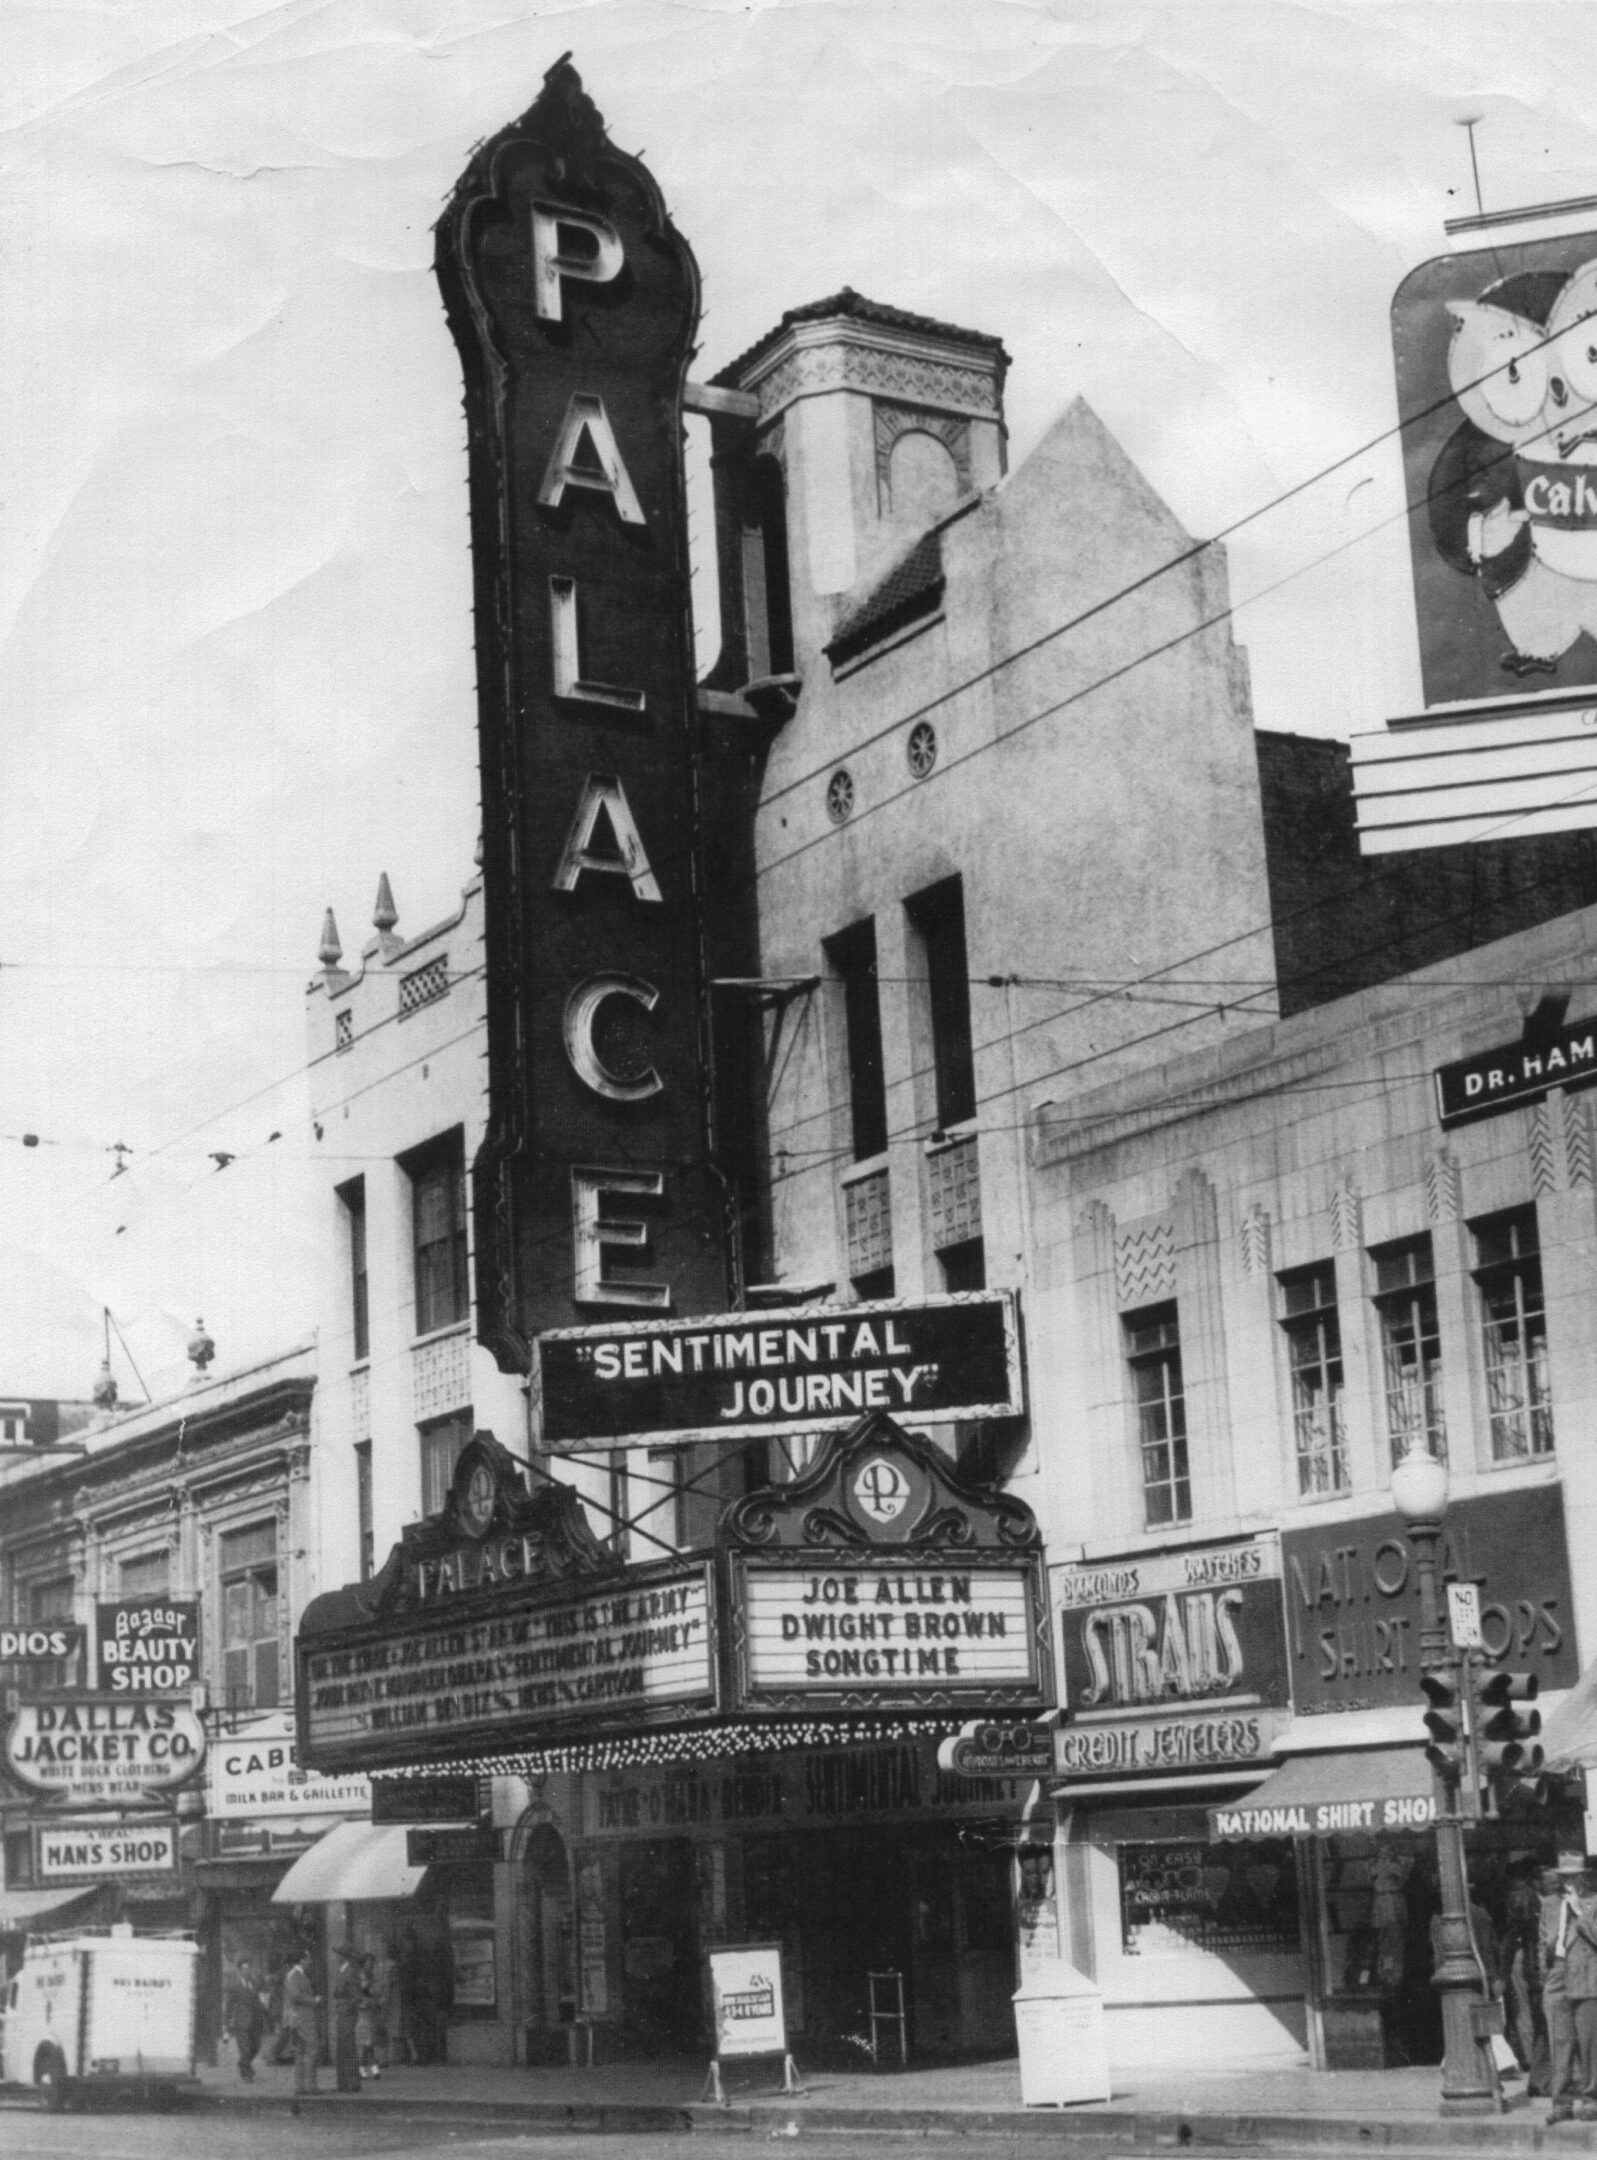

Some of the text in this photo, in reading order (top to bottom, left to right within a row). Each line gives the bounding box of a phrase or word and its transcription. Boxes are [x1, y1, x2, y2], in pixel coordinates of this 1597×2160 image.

[531, 200, 673, 1310] PALACE
[1465, 1069, 1515, 1096] DR.
[419, 1530, 541, 1598] PALACE
[1184, 1550, 1262, 1585] WATCHES
[803, 1575, 972, 1604] JOE ALLEN
[1454, 1590, 1473, 1606] NO
[116, 1608, 187, 1639] Bazaar
[604, 1597, 629, 1627] THE
[782, 1611, 1006, 1641] DWIGHT BROWN
[1, 1632, 67, 1656] DIOS
[103, 1637, 196, 1663] BEAUTY
[805, 1648, 961, 1678] SONGTIME
[111, 1665, 191, 1690] SHOP
[37, 1704, 176, 1731] DALLAS
[14, 1733, 197, 1761] JACKET CO.
[1064, 1718, 1260, 1773] CREDIT JEWELERS
[115, 1761, 171, 1777] CLOTHING
[226, 1785, 369, 1804] MILK BAR & GRILLETTE
[1217, 1808, 1310, 1834] NATIONAL
[1317, 1803, 1375, 1830] SHIRT
[110, 1840, 168, 1864] SHOP
